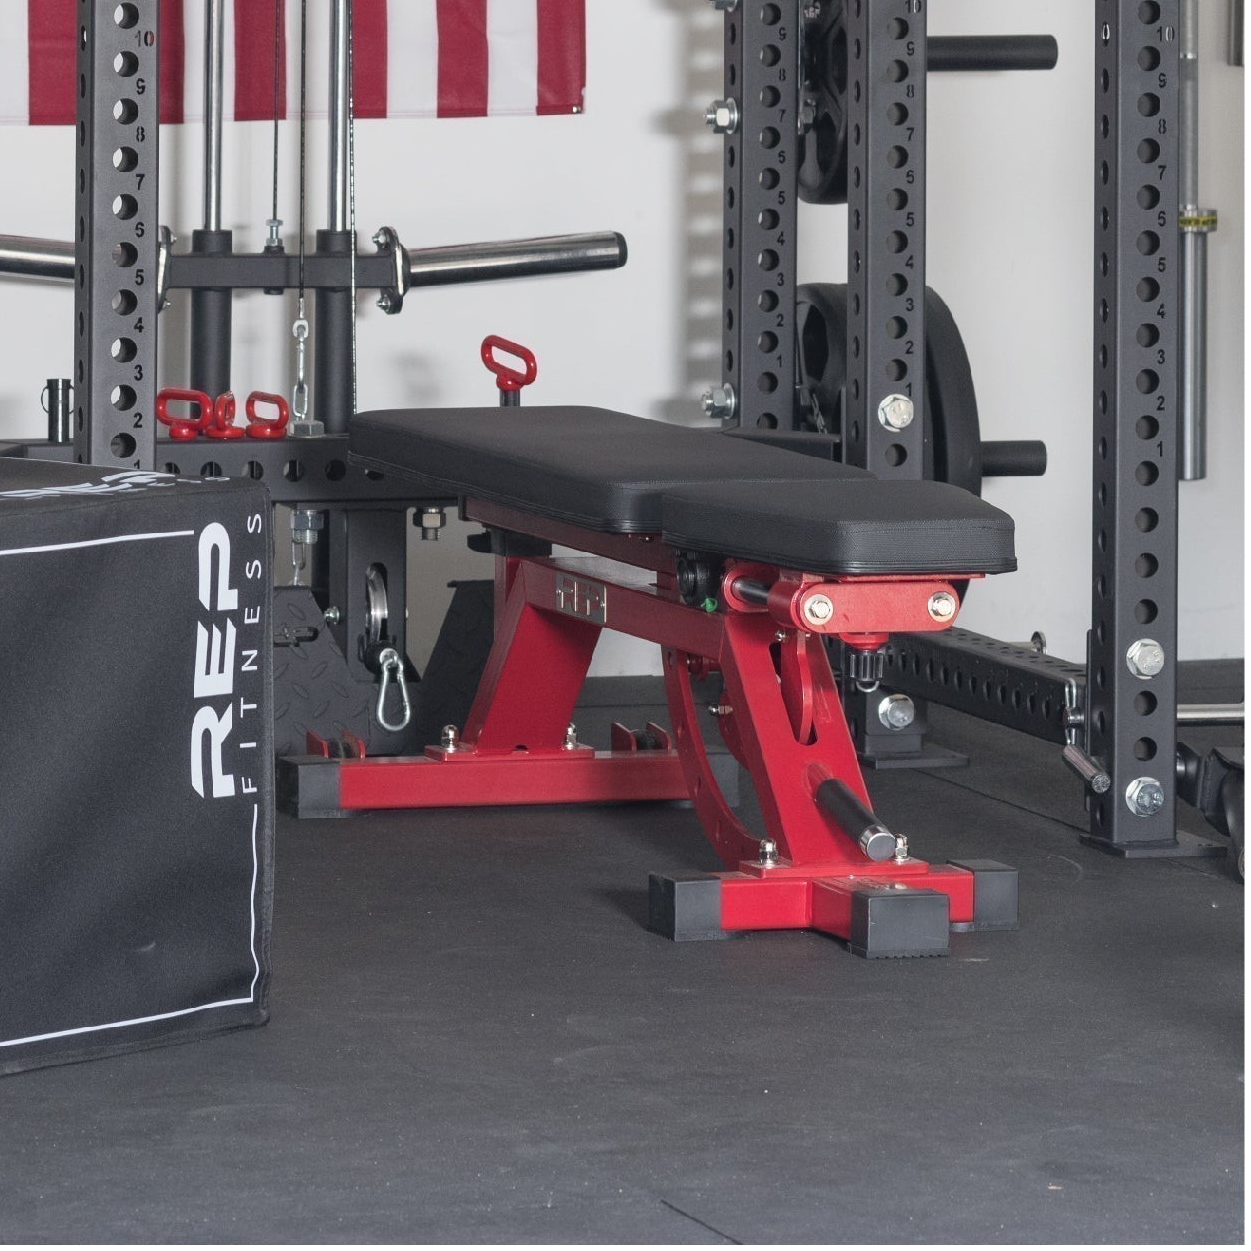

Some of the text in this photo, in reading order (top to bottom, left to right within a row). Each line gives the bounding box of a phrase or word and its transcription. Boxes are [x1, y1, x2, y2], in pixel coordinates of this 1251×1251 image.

[905, 0, 920, 13] 10
[135, 30, 154, 47] 10
[1157, 26, 1174, 42] 10
[907, 84, 914, 99] 8
[906, 127, 914, 141] 7
[1158, 118, 1167, 134] 8
[136, 126, 145, 143] 8
[1158, 165, 1166, 180] 7
[136, 174, 145, 190] 7
[906, 212, 914, 226] 5
[905, 255, 914, 269] 4
[1158, 257, 1166, 272] 5
[135, 269, 144, 286] 5
[906, 298, 914, 311] 3
[1157, 303, 1166, 319] 4
[134, 317, 144, 334] 4
[905, 340, 914, 354] 2
[1157, 349, 1165, 365] 3
[134, 364, 143, 382] 3
[906, 383, 912, 396] 1
[1157, 395, 1165, 411] 2
[134, 412, 143, 429] 2
[1157, 441, 1162, 457] 1
[190, 522, 238, 798] REP
[240, 513, 262, 794] FITNESS
